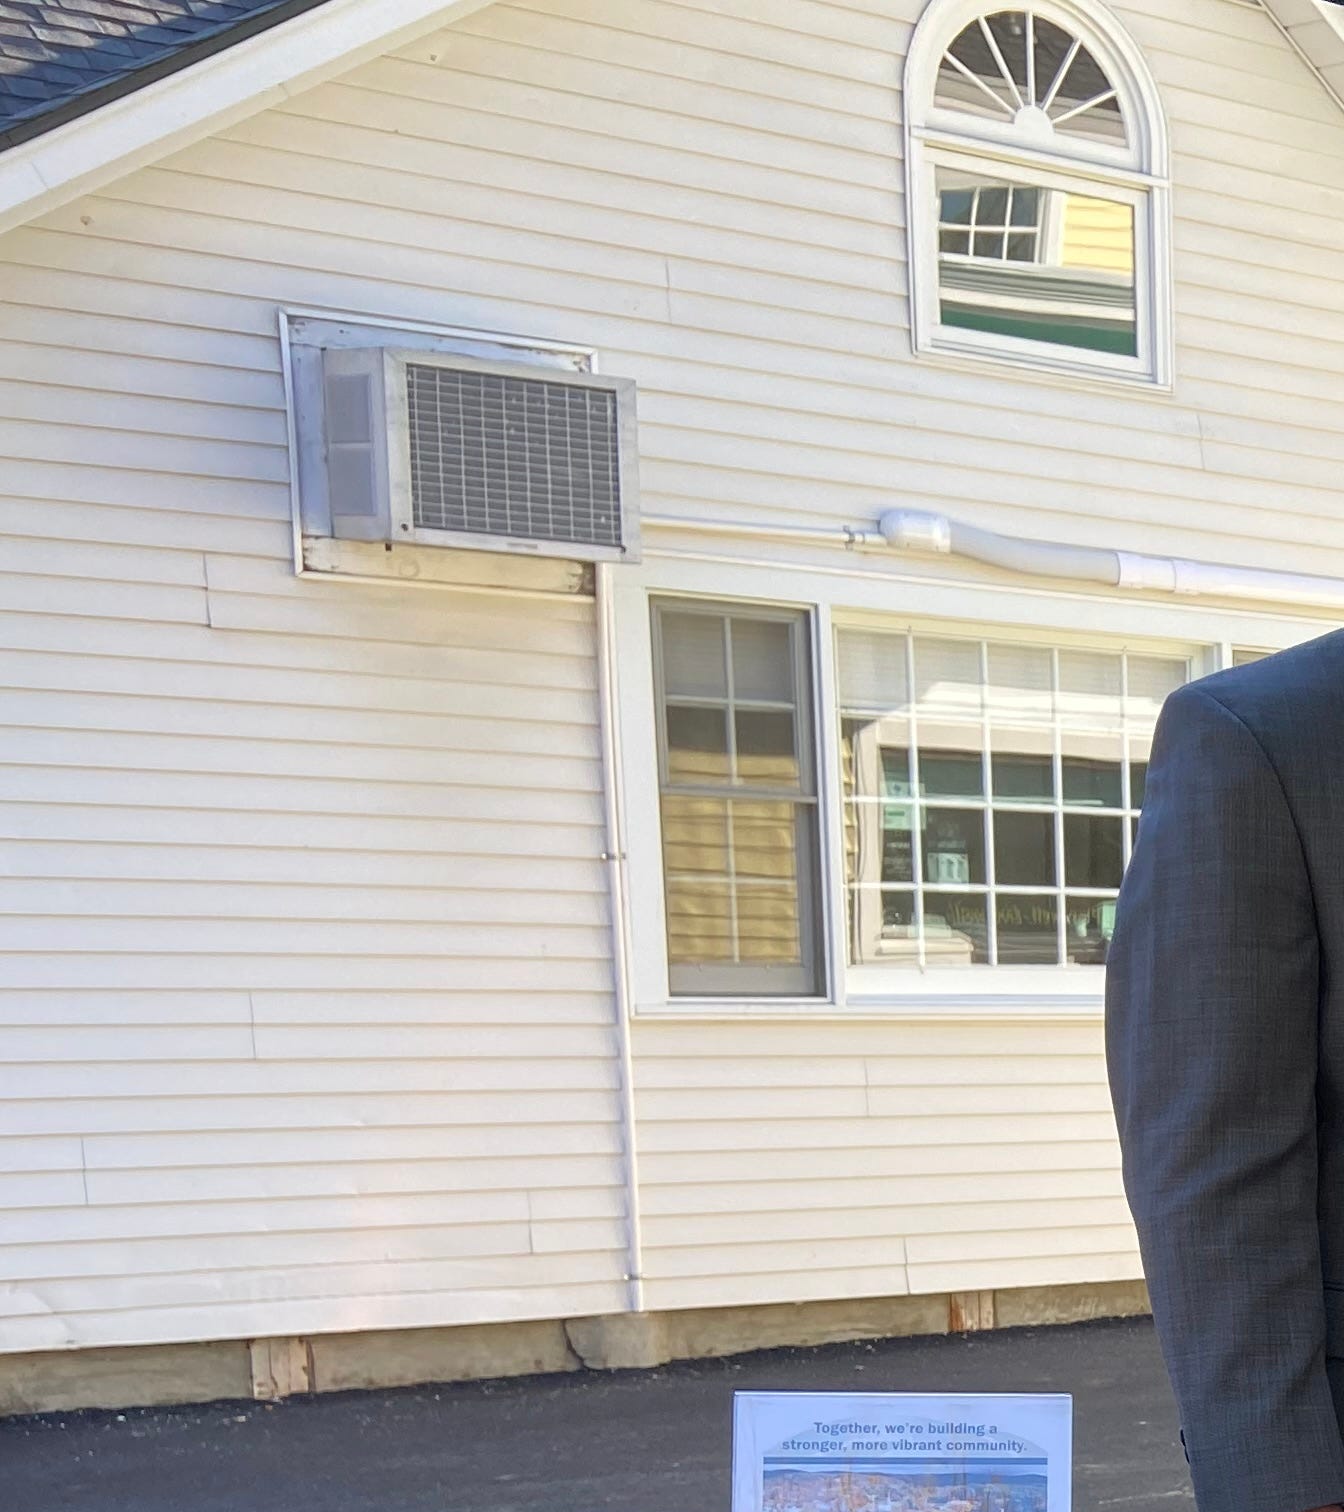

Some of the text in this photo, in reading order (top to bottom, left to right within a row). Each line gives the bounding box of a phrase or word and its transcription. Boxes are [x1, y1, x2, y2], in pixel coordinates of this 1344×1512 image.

[814, 1422, 998, 1436] Together, we're building a
[782, 1439, 1027, 1453] stronger, more vibrant community.
